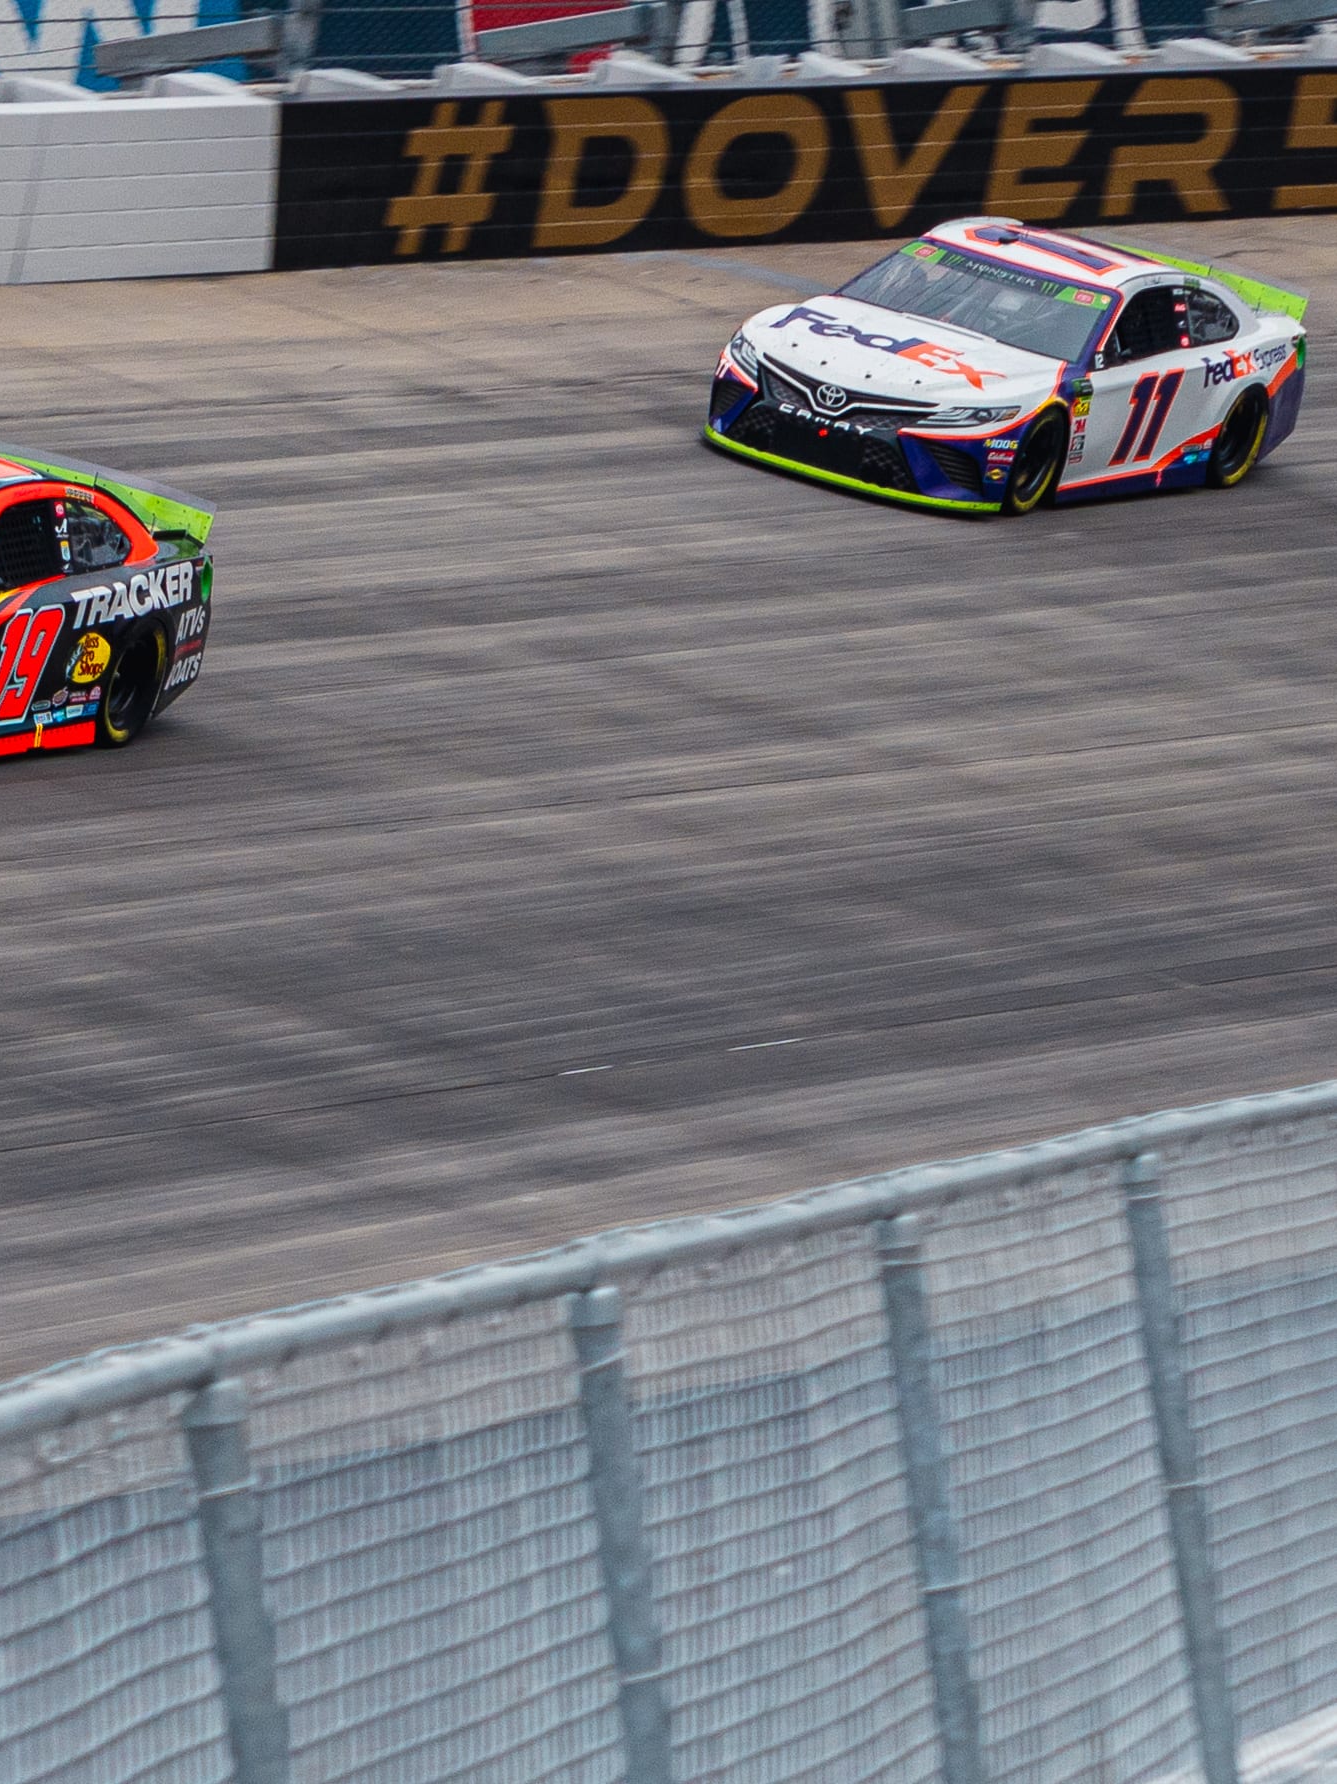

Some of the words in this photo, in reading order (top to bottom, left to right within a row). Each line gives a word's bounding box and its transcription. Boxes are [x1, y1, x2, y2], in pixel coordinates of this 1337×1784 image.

[965, 260, 1038, 287] MONSTER
[769, 306, 1008, 391] FedEx
[1201, 349, 1257, 389] FedEx
[778, 402, 873, 435] CAMRY
[1106, 368, 1185, 468] 11
[983, 439, 1019, 450] MOOG
[70, 561, 194, 630] TRACKER
[175, 606, 206, 645] ATVs
[164, 651, 202, 691] OATS
